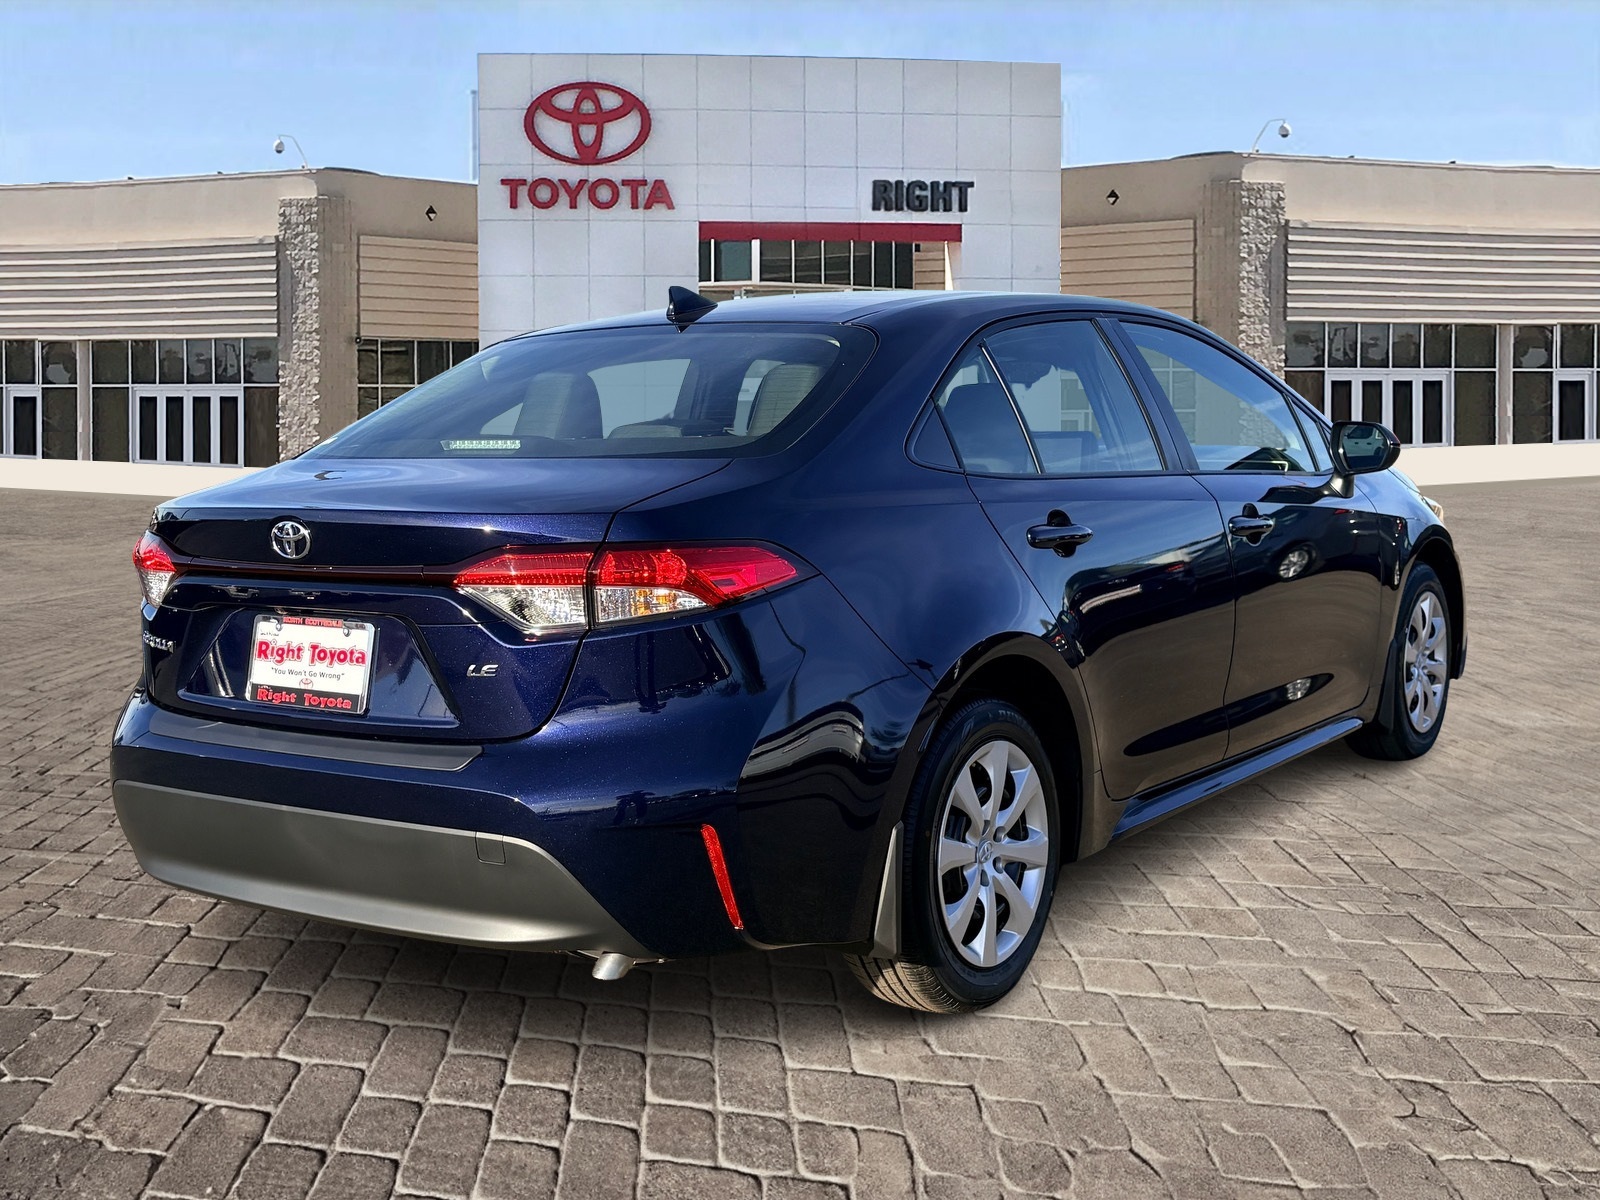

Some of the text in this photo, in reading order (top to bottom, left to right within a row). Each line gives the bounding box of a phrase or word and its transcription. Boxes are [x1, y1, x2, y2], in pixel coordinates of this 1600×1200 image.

[501, 178, 675, 211] TOYOTA
[871, 179, 975, 213] RIGHT
[257, 640, 366, 667] Right Toyota
[288, 669, 307, 677] Won't
[309, 670, 318, 678] Go
[466, 664, 499, 677] LE
[257, 688, 352, 709] Right Toyota
